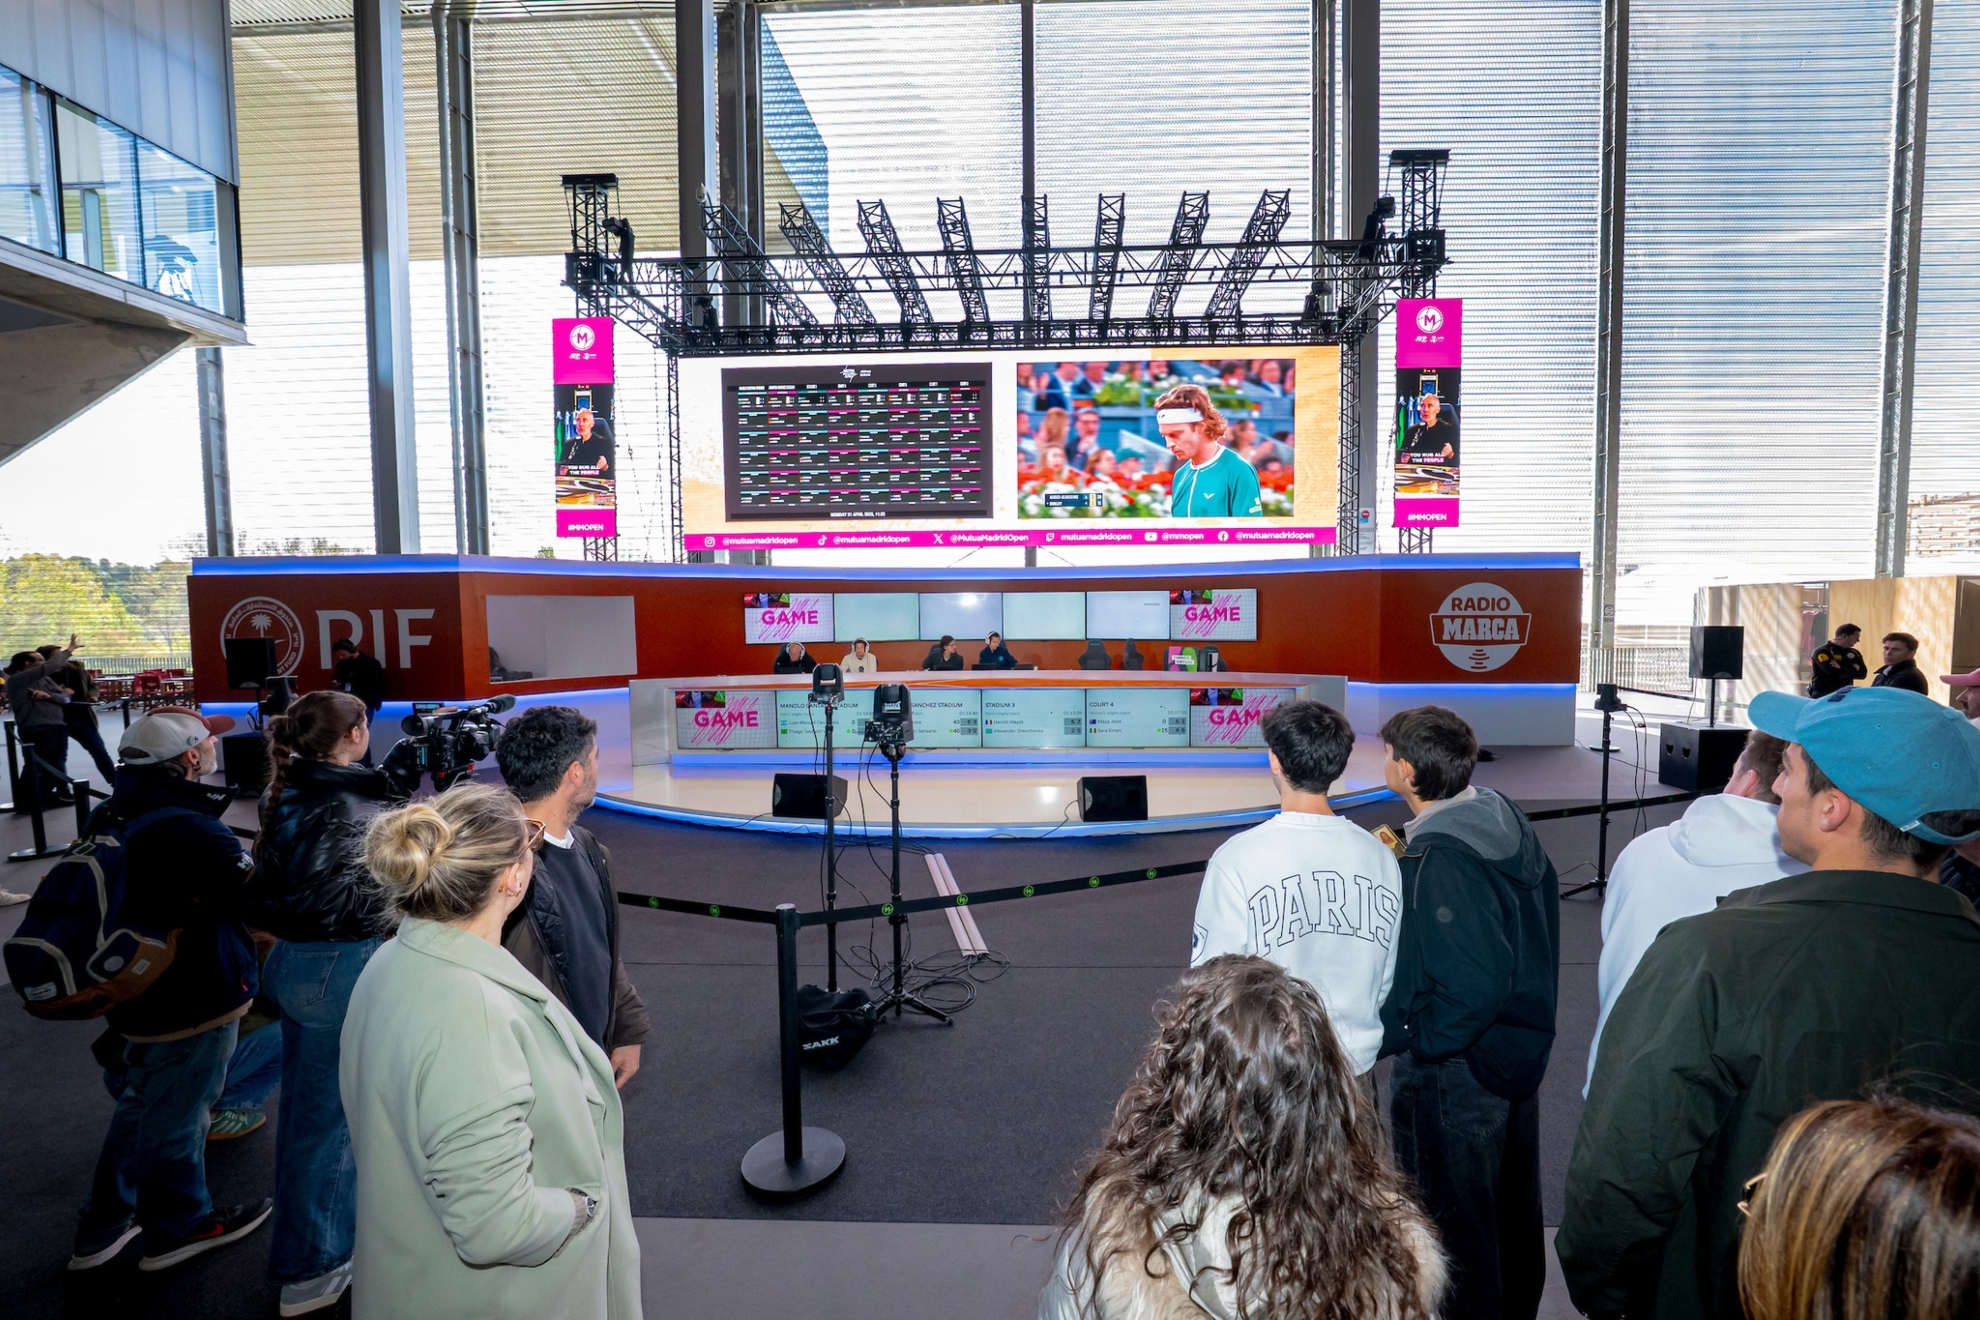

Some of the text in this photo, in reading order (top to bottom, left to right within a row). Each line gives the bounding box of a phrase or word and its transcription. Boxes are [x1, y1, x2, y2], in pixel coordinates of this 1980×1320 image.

[1424, 314, 1436, 326] M
[577, 332, 588, 344] M
[722, 531, 1314, 546] @mutuamadridopen @mutuamadridopen @MutuaMadridOpen mutuamadridopen @mmopen @mutuamadridopen
[1451, 597, 1510, 611] RADIO
[762, 610, 818, 625] GAME
[1184, 606, 1240, 622] GAME
[1442, 618, 1520, 640] MARCA
[315, 608, 436, 669] PIF
[285, 652, 296, 668] FUND
[694, 710, 759, 727] GAME
[1248, 871, 1400, 957] PARIS
